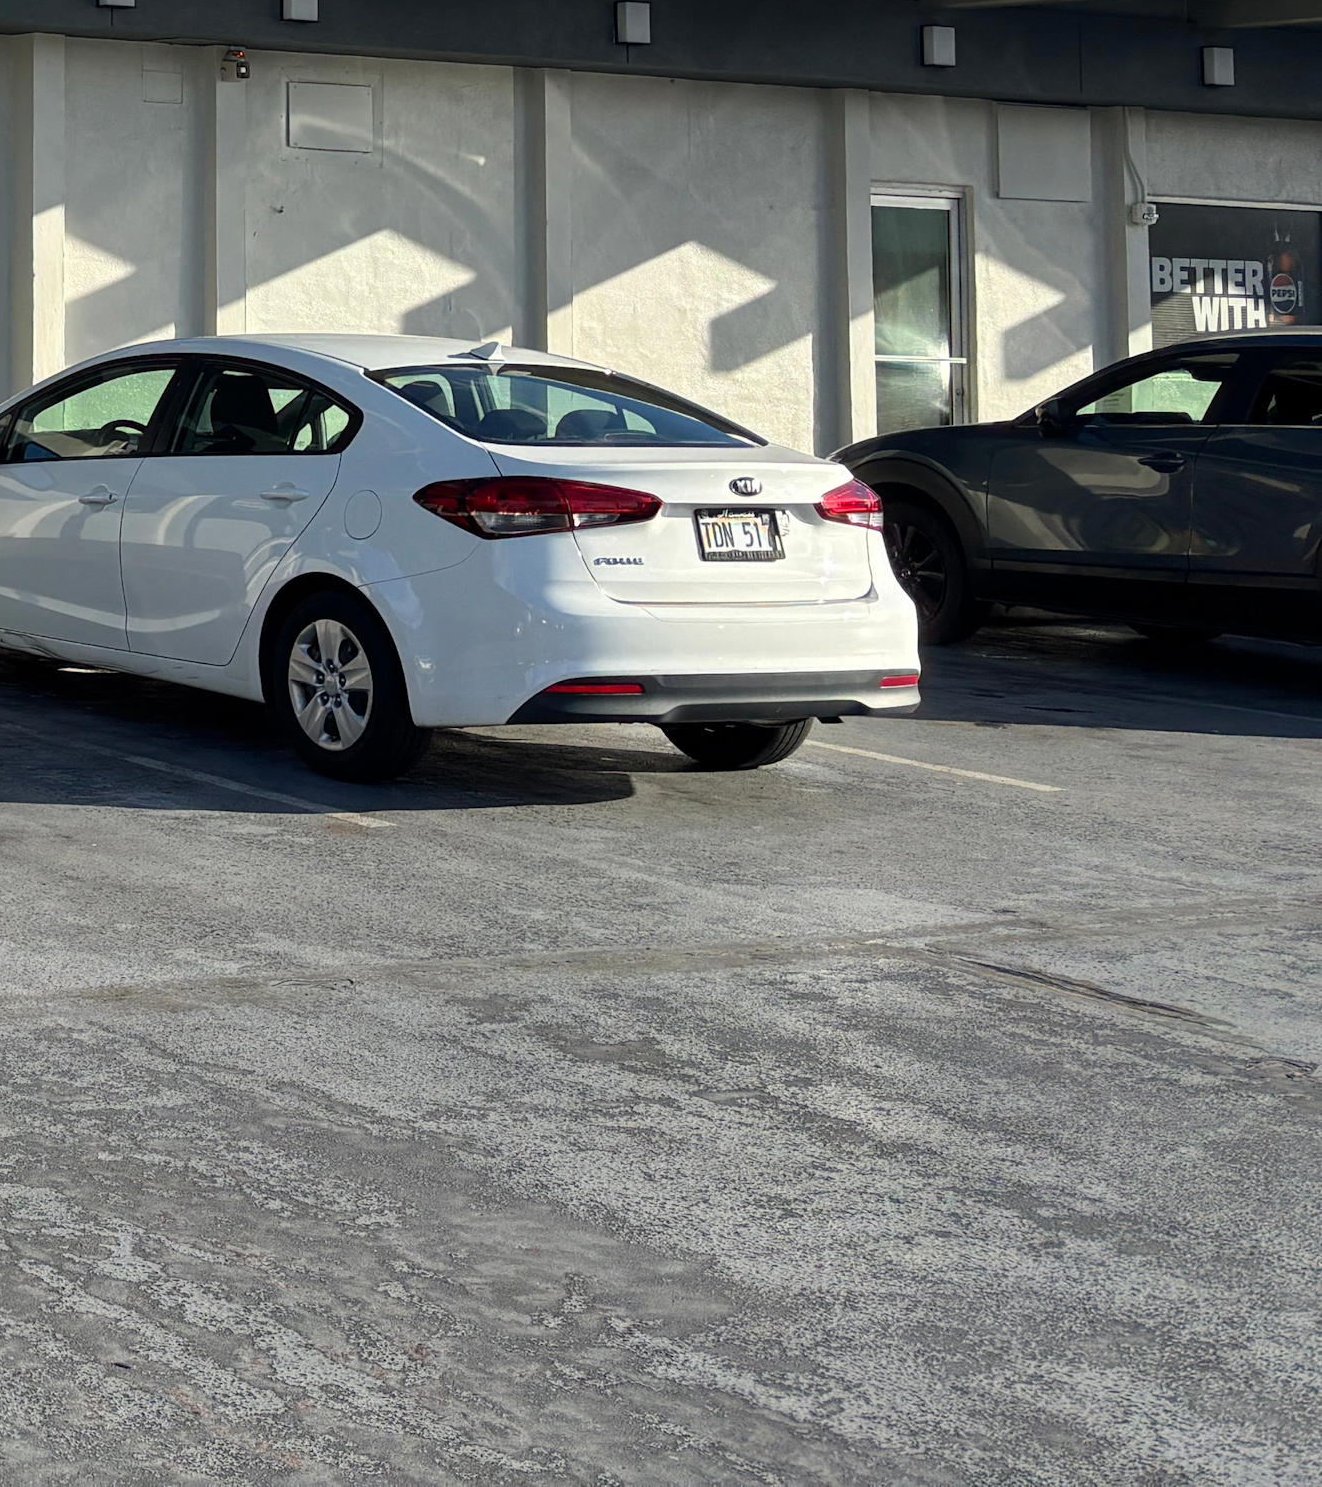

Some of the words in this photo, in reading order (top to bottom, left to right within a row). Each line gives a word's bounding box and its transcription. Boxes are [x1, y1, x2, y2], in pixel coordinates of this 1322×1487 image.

[1151, 256, 1265, 296] BETTER
[1271, 288, 1295, 298] PEPSI
[1192, 296, 1267, 332] WITH
[701, 522, 735, 548] TDN
